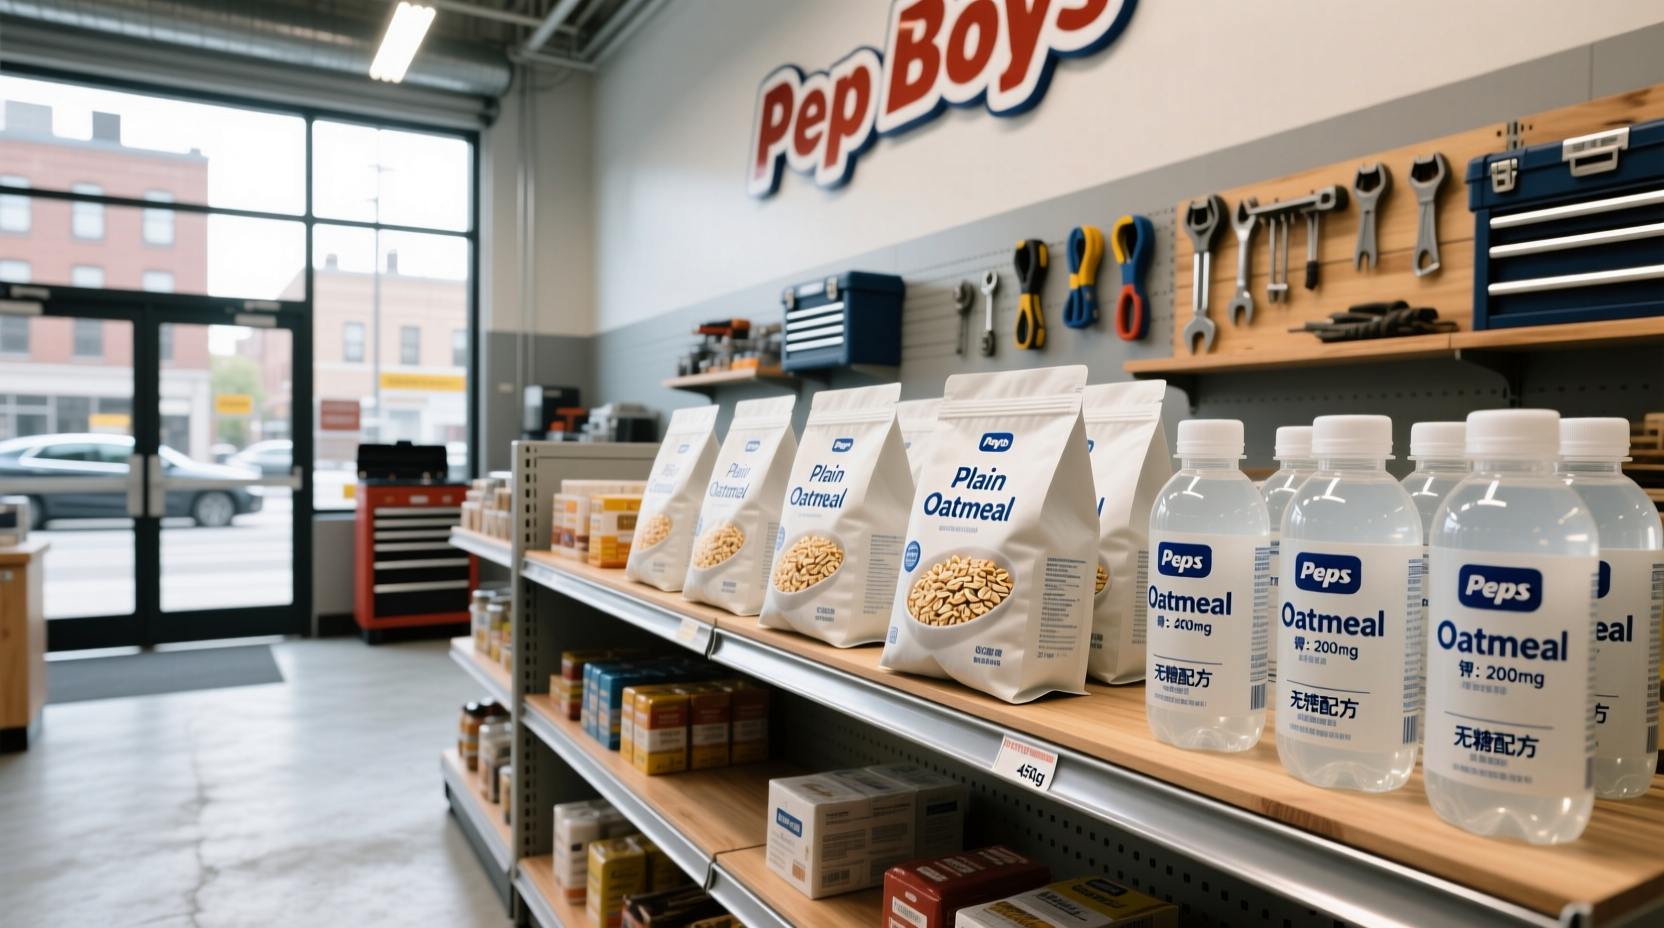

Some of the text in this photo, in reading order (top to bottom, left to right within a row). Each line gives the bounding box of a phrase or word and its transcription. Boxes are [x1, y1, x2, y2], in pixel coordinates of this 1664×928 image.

[754, 63, 872, 182] Pep
[808, 463, 845, 483] Plain
[950, 466, 1008, 492] Plain
[923, 491, 1017, 523] Oatmeal
[1160, 549, 1204, 574] Peps
[1299, 561, 1353, 589] Peps
[1148, 584, 1233, 616] Oatmeal
[1464, 574, 1532, 606] Peps
[1281, 601, 1385, 637] Oatmeal
[1314, 640, 1359, 661] 200mg
[1437, 619, 1569, 662] Oatmeal
[1486, 664, 1545, 690] 200mg
